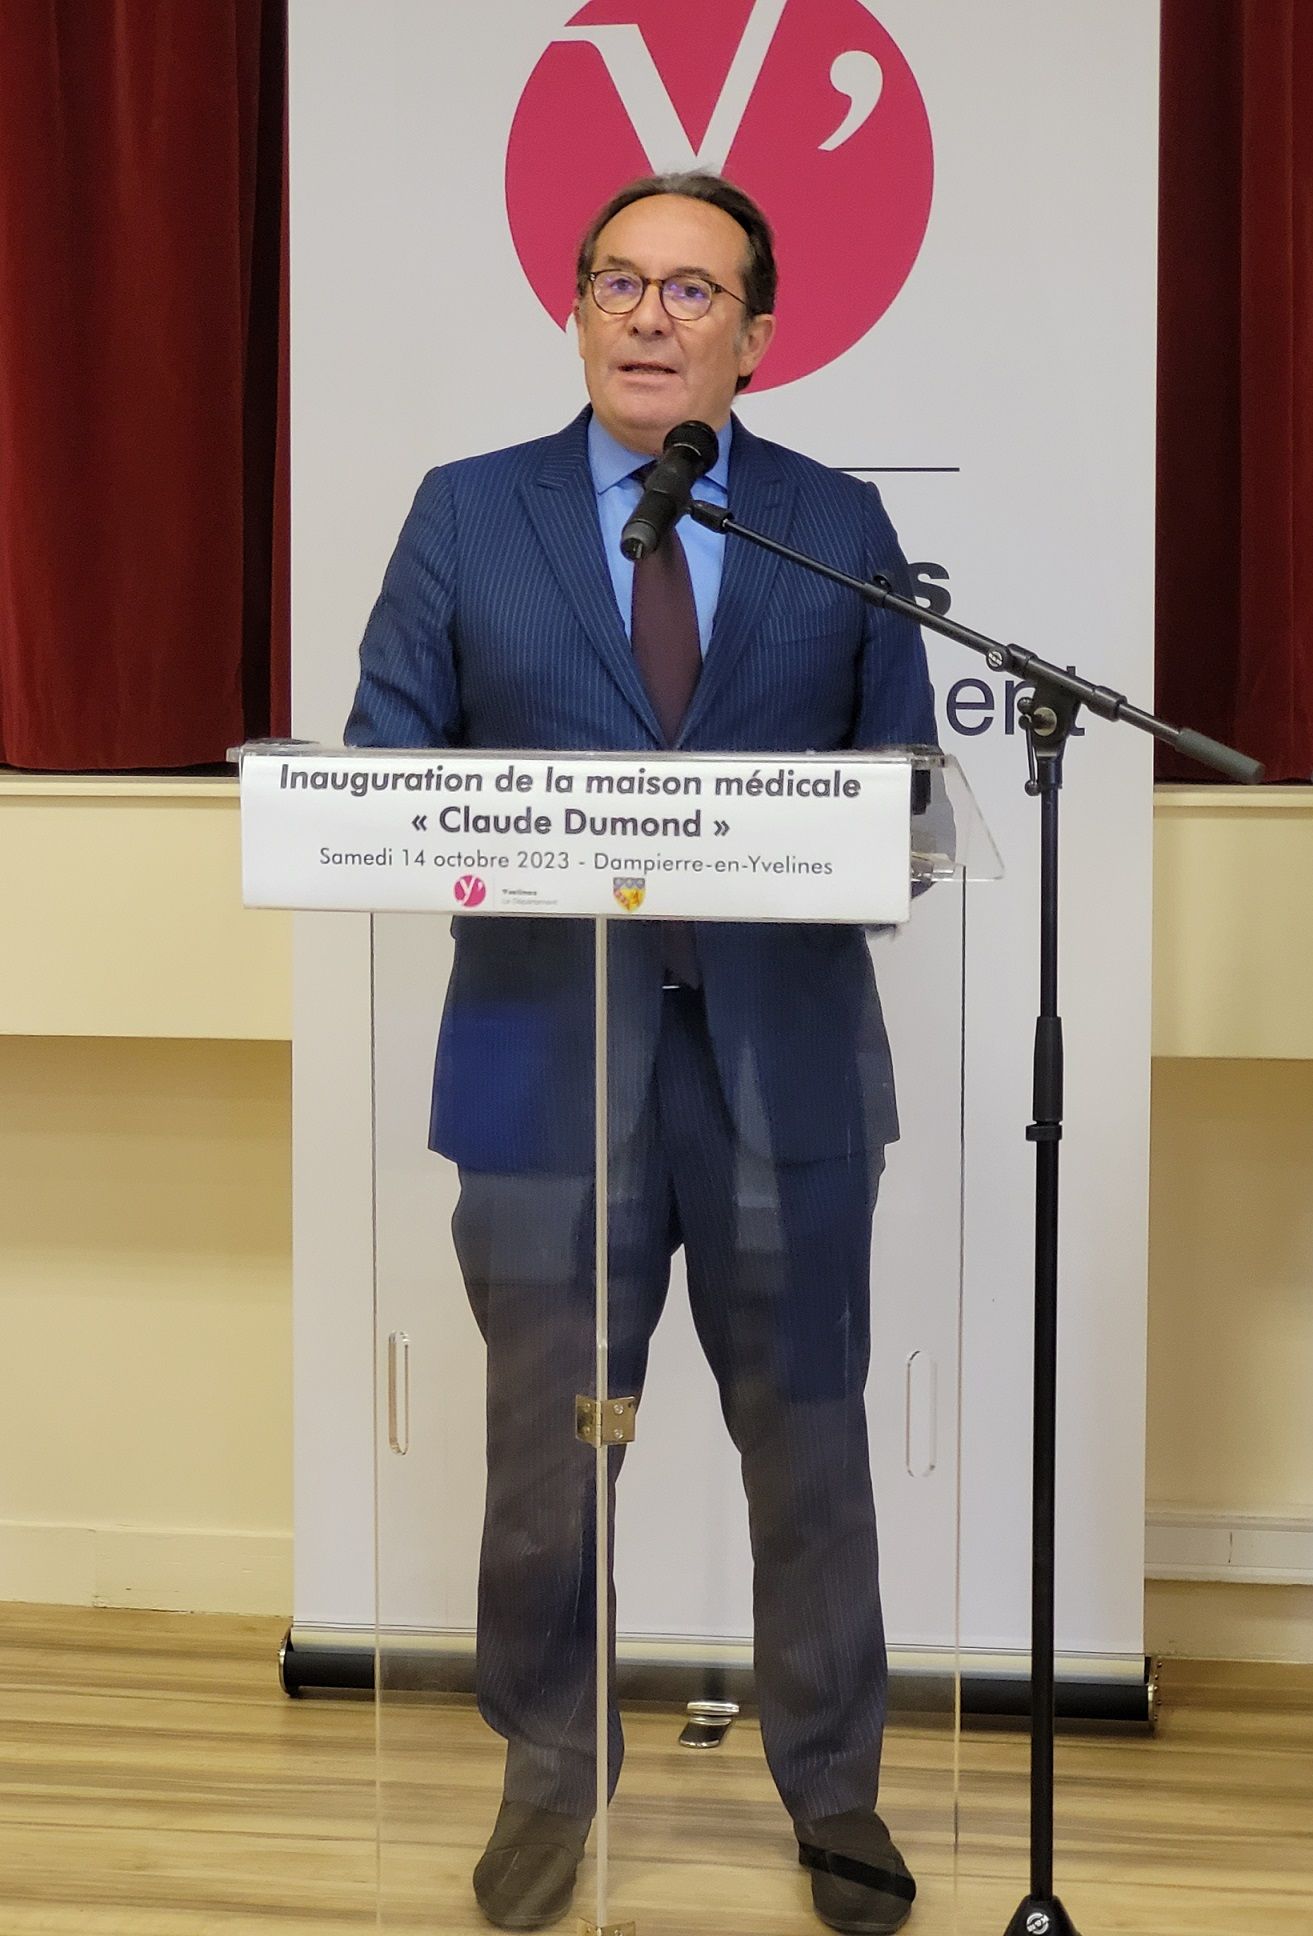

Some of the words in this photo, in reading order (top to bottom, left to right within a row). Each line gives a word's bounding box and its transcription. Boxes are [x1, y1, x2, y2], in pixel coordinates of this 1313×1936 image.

[280, 763, 483, 798] Inauguration
[495, 765, 534, 793] de
[545, 766, 574, 794] la
[585, 767, 702, 795] maison
[714, 768, 862, 798] médicale
[439, 805, 552, 835] Claude
[564, 807, 702, 838] Dumond
[319, 847, 393, 866] Samedi
[402, 848, 426, 866] 14
[433, 849, 509, 868] octobre
[517, 851, 569, 870] 2023
[594, 852, 833, 876] Dampierre-en-Yvelines
